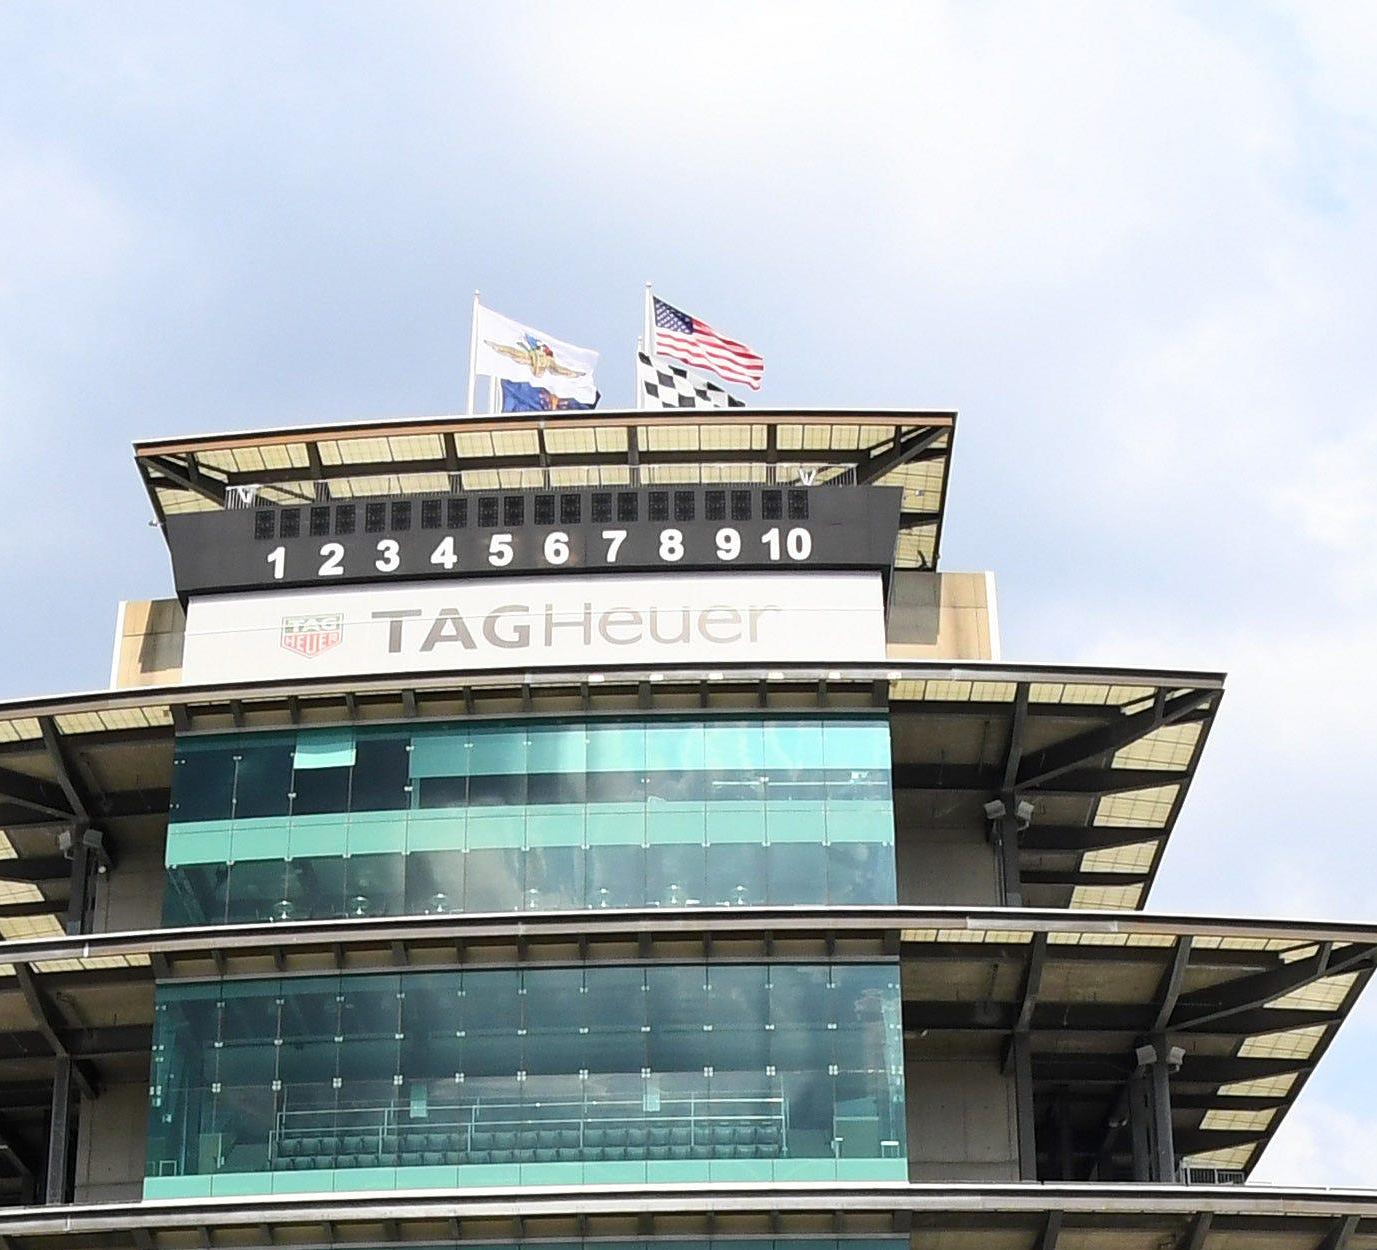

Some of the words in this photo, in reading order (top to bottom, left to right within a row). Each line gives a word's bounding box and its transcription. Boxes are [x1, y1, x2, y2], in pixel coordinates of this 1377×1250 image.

[267, 546, 286, 579] 1
[318, 543, 345, 576] 2
[375, 539, 400, 572] 3
[430, 536, 458, 569] 4
[488, 533, 514, 567] 5
[543, 531, 570, 565] 6
[601, 530, 628, 563] 7
[658, 528, 685, 562] 8
[715, 527, 742, 561] 9
[761, 527, 813, 561] 10
[289, 616, 338, 632] TAG
[284, 631, 340, 656] HEUER
